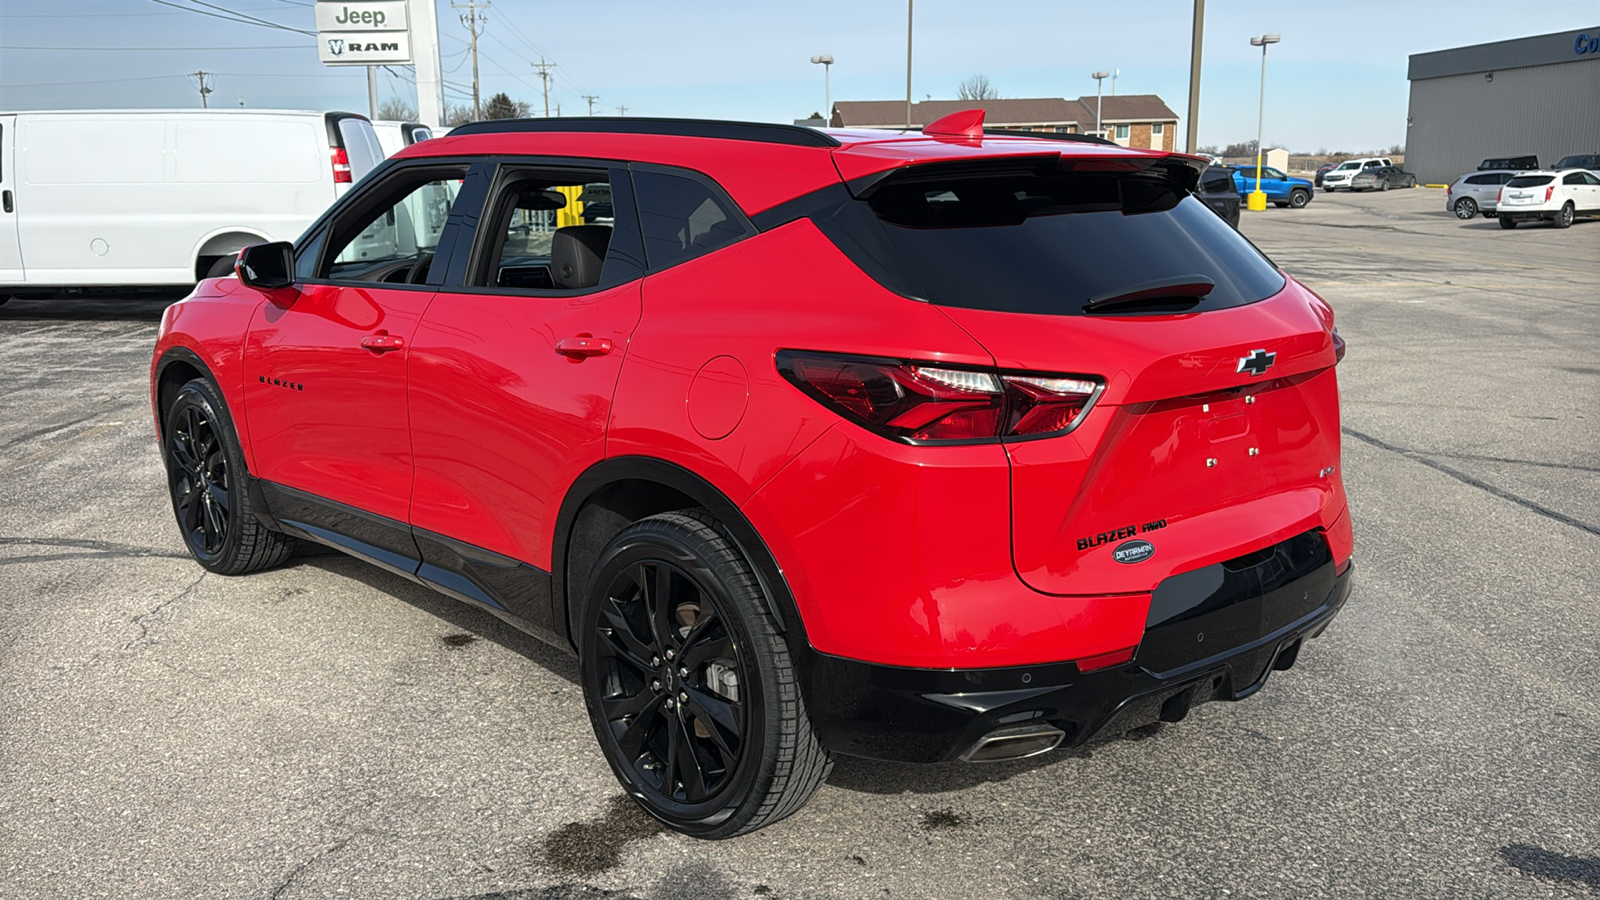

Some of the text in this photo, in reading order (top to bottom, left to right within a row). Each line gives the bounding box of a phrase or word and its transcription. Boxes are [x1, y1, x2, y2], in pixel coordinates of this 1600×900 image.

[335, 6, 386, 27] Jeep
[348, 43, 398, 51] RAM
[259, 376, 303, 391] BLAZER
[1076, 519, 1168, 551] BLAZER AWD
[1115, 543, 1153, 559] DEYARMAN
